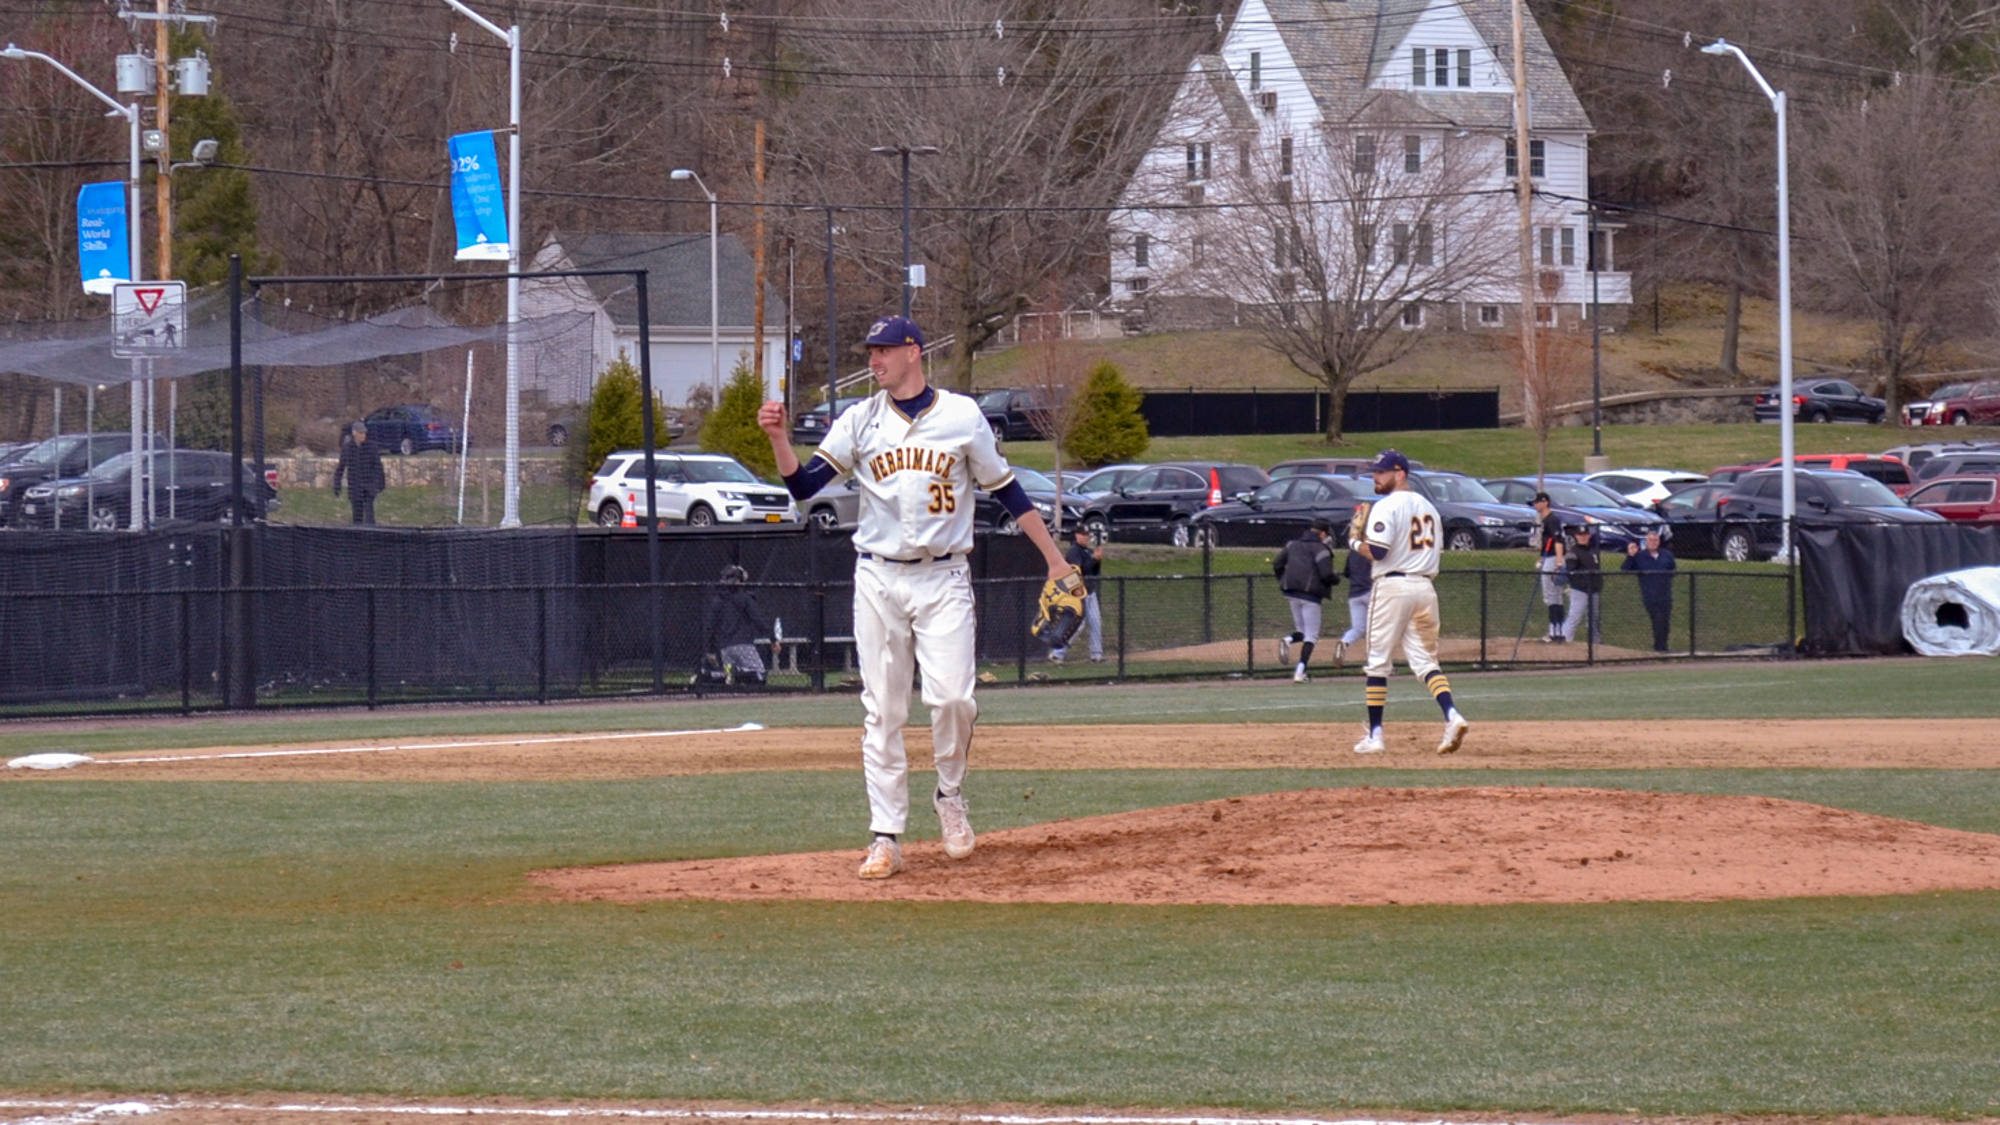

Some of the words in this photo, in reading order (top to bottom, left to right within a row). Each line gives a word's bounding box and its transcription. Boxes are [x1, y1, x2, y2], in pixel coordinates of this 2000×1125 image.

[82, 218, 105, 228] Real-
[82, 229, 111, 238] World
[82, 240, 107, 251] Skills
[869, 447, 956, 483] MERRIMACK
[927, 483, 956, 515] 35
[1410, 514, 1435, 551] 23
